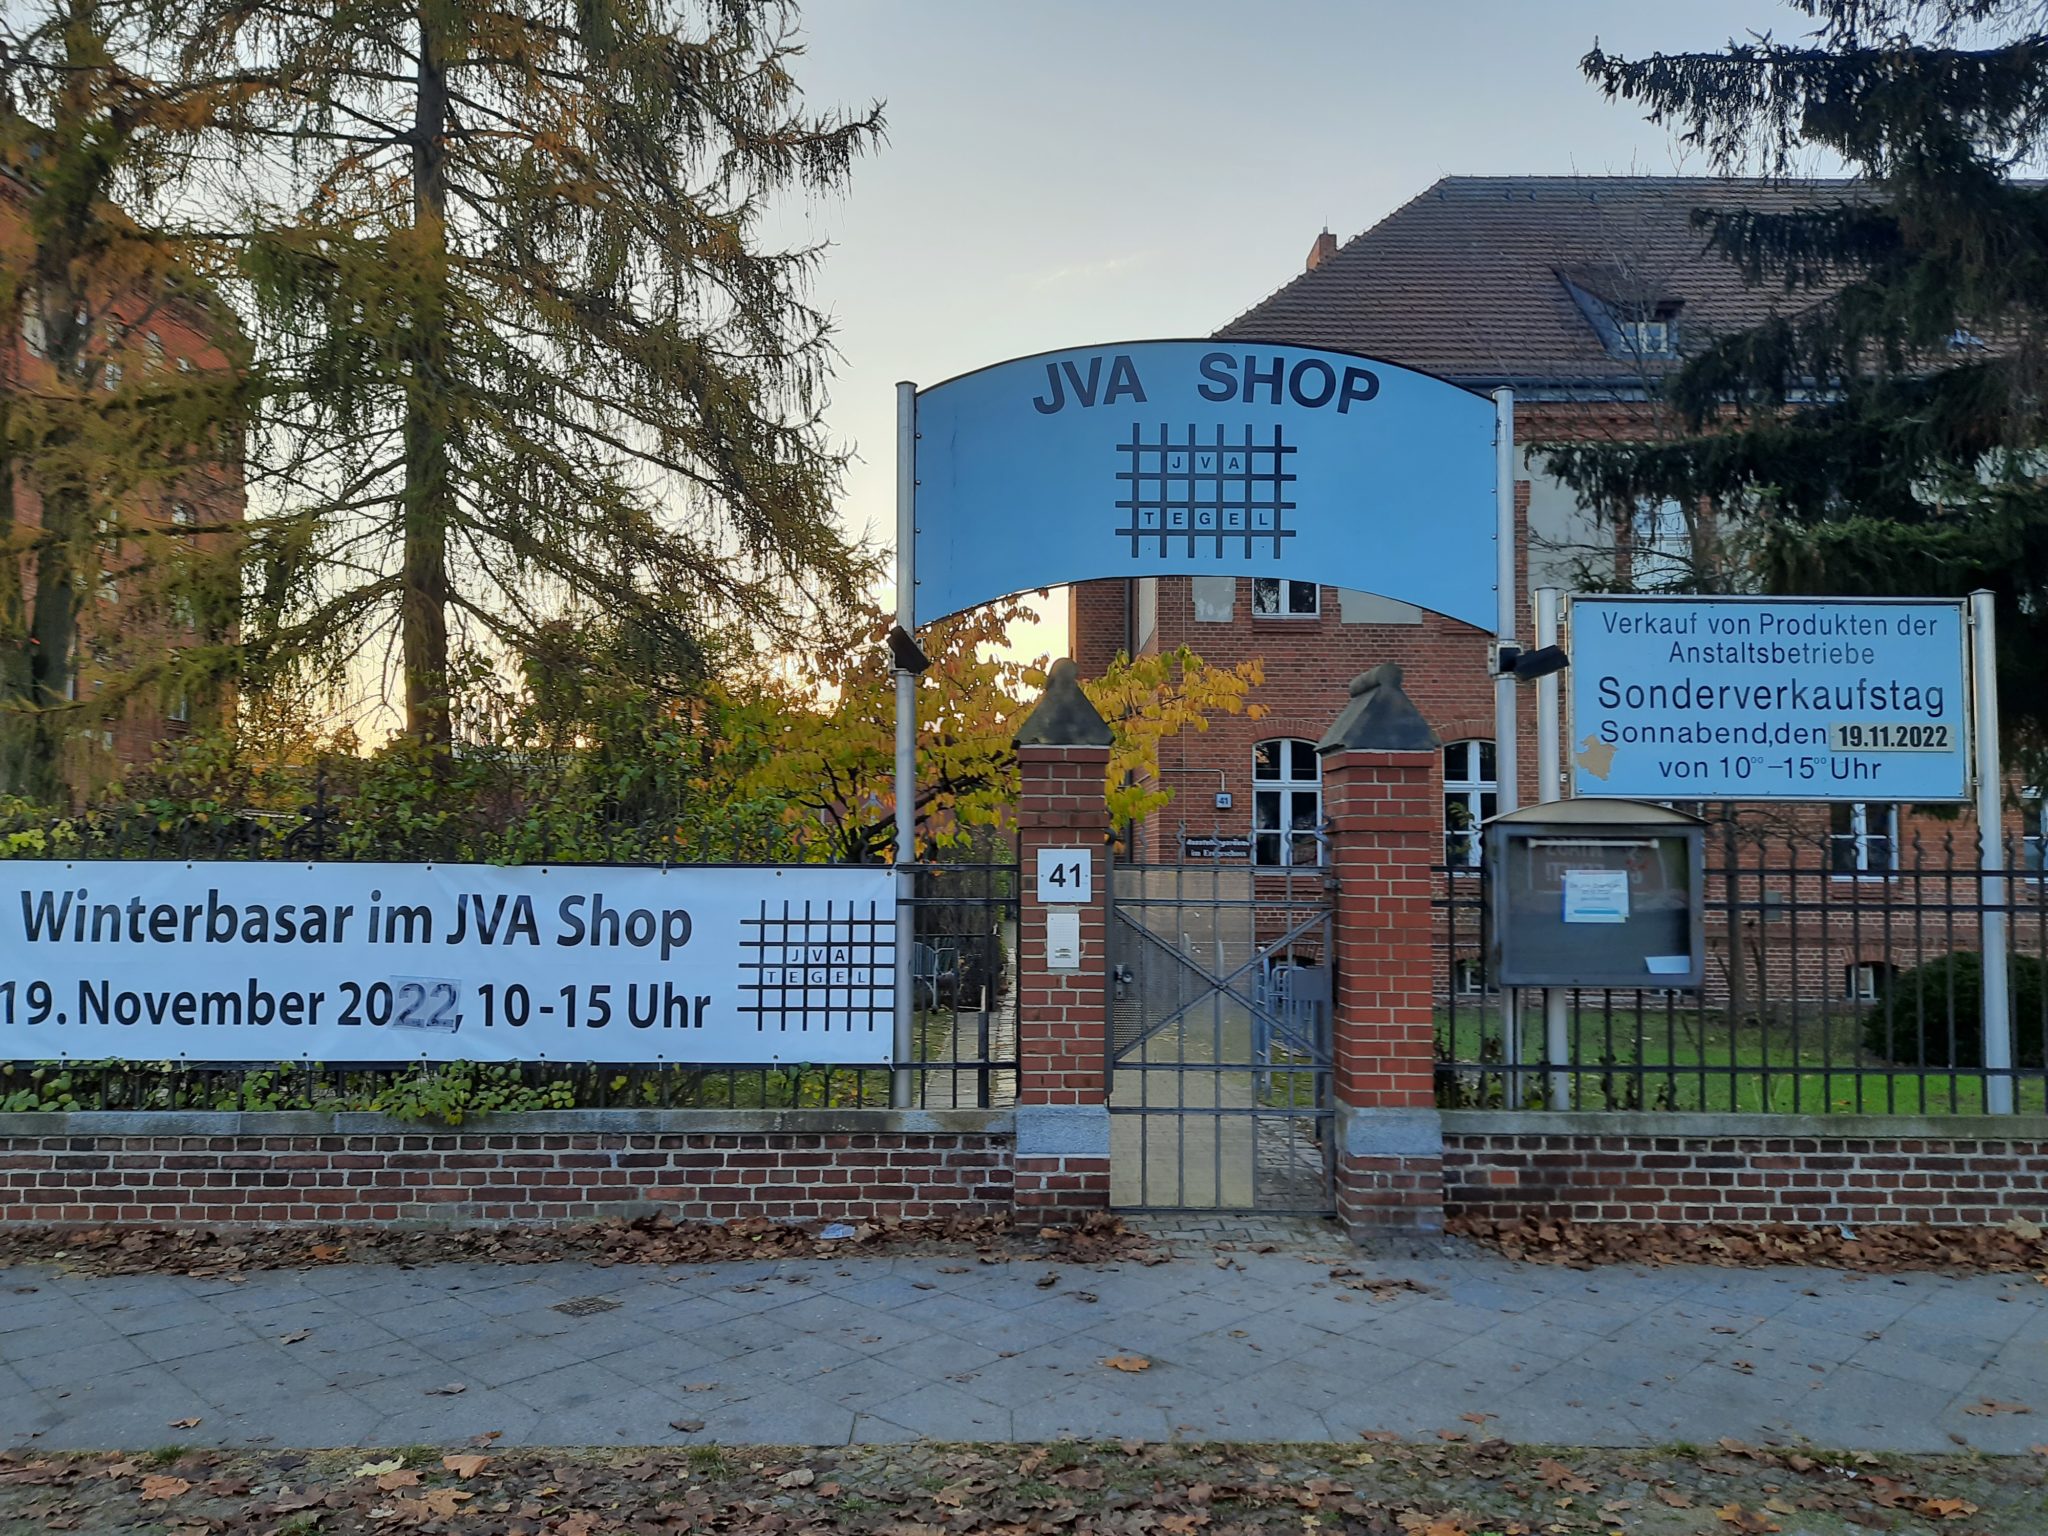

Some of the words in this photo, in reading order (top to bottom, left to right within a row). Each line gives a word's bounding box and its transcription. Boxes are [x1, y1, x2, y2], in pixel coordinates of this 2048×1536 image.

[1032, 354, 1147, 414] JVA
[1197, 351, 1380, 414] SHOP
[1171, 456, 1240, 470] JVA
[1144, 511, 1269, 526] TEGEL
[1602, 612, 1697, 635] Verkauf
[1708, 617, 1751, 635] von
[1760, 613, 1887, 636] Produkten
[1897, 614, 1938, 636] der
[1669, 641, 1875, 665] Anstaltsbetriebe
[1598, 676, 1944, 718] Sonderverkaufstag
[1838, 725, 1949, 748] 19.11.2022
[1658, 761, 1709, 778] von
[1831, 757, 1882, 779] Uhr
[1048, 863, 1081, 888] 41
[20, 889, 354, 944] Winterbasar
[368, 890, 433, 944] im
[446, 893, 541, 946] JVA
[556, 893, 692, 961] Shop
[792, 949, 845, 962] JVA
[767, 971, 866, 984] TEGEL
[0, 980, 67, 1026] 19.
[78, 978, 325, 1027] November
[337, 981, 464, 1034] 2022,
[628, 981, 711, 1029] Uhr
